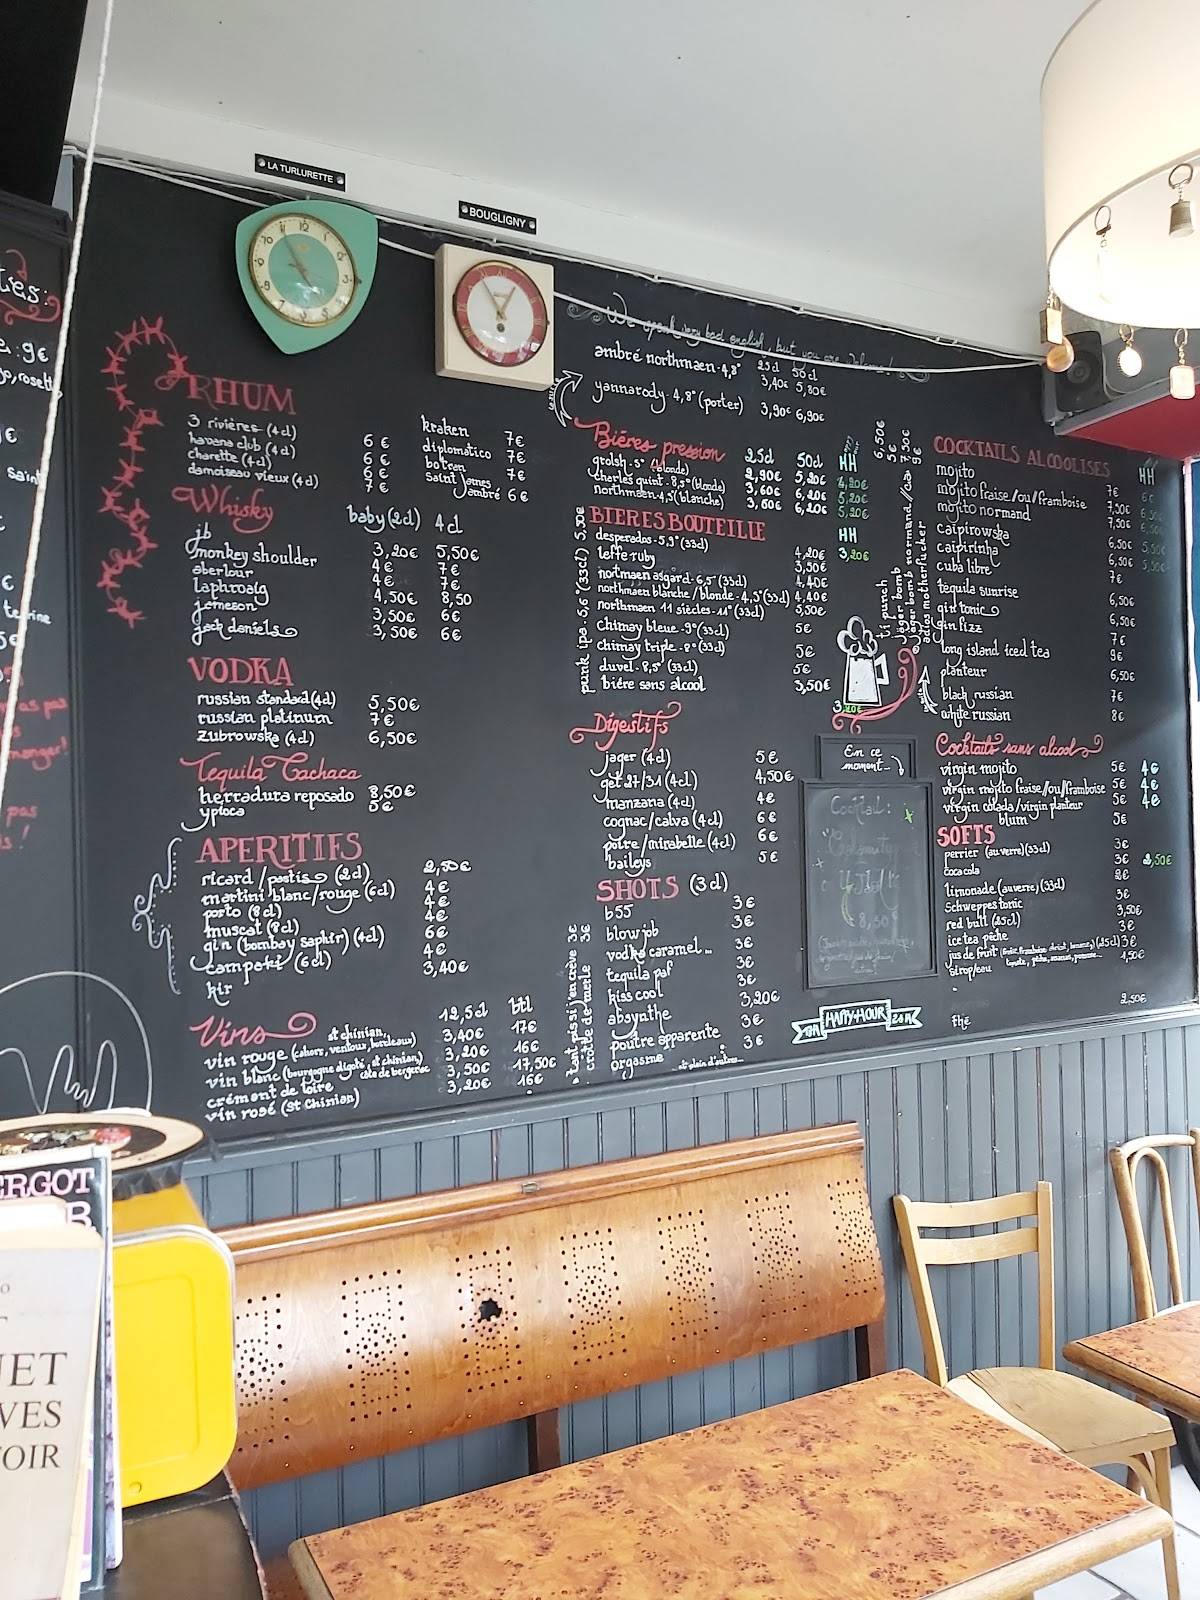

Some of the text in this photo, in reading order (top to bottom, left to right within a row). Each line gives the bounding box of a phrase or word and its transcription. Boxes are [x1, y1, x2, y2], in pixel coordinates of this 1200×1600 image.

[267, 161, 334, 183] LA TURLURETTE
[299, 222, 310, 232] 12
[469, 207, 526, 228] BOUGLIGNY
[594, 341, 643, 363] ambré
[761, 374, 789, 390] 3,40€
[186, 374, 297, 415] RHUM
[699, 391, 744, 415] (porter)
[187, 413, 264, 433] 3 rivières
[760, 402, 825, 423] 3,90€ 6,90€
[420, 414, 470, 437] kraken
[188, 431, 261, 451] havana club
[422, 438, 492, 462] diplomatico
[188, 447, 239, 463] charette
[933, 435, 1111, 479] COCKTAILS ALCOOLISES
[188, 462, 290, 483] damoiseau vieux
[594, 473, 726, 494] charles quint (blonde)
[744, 467, 827, 486] 2,90€ 5,20€
[936, 462, 975, 487] mojito
[745, 482, 827, 503] 3,60€ 6,20€
[937, 482, 978, 506] mojito
[172, 484, 274, 533] Whisky
[588, 505, 666, 531] BIERES
[794, 502, 828, 516] 6,20€
[937, 500, 1131, 524] mojito normand 7,50€
[904, 500, 914, 566] normand
[1107, 516, 1132, 530] 7,50€
[595, 527, 870, 563] desperados 4,20€ 3,20€
[838, 527, 858, 544] HH
[937, 521, 1133, 551] caipirowska 6,50€
[190, 542, 318, 568] monkey shoulder
[372, 541, 480, 561] 3,20€ 5,50€
[631, 548, 827, 575] ruby 3,50€
[936, 540, 1135, 569] caipirinha 6,50€
[192, 561, 254, 579] aberlour
[915, 520, 932, 611] motherfucker
[936, 559, 992, 576] cuba libre
[193, 577, 270, 606] laphroaig
[794, 575, 829, 589] 4,40€
[937, 578, 1136, 608] tequila sunrise 6,50€
[373, 588, 473, 609] 4,50€ 8,50
[875, 578, 897, 621] punch
[372, 608, 416, 625] 3,50€
[645, 617, 680, 634] bleue
[959, 616, 984, 634] fizz
[1109, 615, 1137, 628] 6,50€
[228, 617, 418, 641] daniels 3,50€
[644, 639, 678, 663] triple
[941, 638, 1051, 668] long island iced tea
[187, 657, 294, 687] VODKA
[598, 659, 634, 673] duvel
[940, 658, 1136, 688] planteur 6,50€
[638, 676, 832, 695] sans alcool 3,50€
[197, 691, 421, 713] russian 5,50€
[942, 687, 976, 709] black
[974, 687, 1014, 701] russian
[197, 707, 334, 730] russian platinum
[972, 708, 1012, 722] russian
[368, 731, 418, 748] 6,50€
[936, 731, 1035, 757] Cocktails sans
[754, 768, 795, 786] 4,50€
[940, 759, 1018, 788] virgin mojito
[198, 785, 355, 811] herradura reposado
[605, 797, 666, 811] manzana
[998, 812, 1029, 827] blum
[937, 824, 996, 848] SOFTS
[194, 832, 364, 870] APERITIFS
[944, 849, 979, 869] perrier
[606, 852, 652, 877] baileys
[201, 866, 255, 887] ricard
[200, 887, 266, 906] martini
[596, 875, 680, 902] SHOTS
[944, 881, 997, 899] limonade
[203, 903, 242, 933] porto
[604, 903, 634, 921] b55
[945, 904, 1143, 932] red bull 3,50€
[204, 918, 263, 939] muscat
[648, 935, 703, 958] caramel
[422, 959, 470, 978] 3,40€
[606, 960, 674, 993] tequila paf
[206, 981, 233, 1007] kir
[508, 995, 534, 1016] btl
[635, 980, 781, 1009] cool 3,20€
[189, 1011, 317, 1048] Vins
[442, 1019, 538, 1044] 3,40€ 17€
[607, 1003, 672, 1040] absynthe
[609, 1022, 722, 1060] poutre apparente
[203, 1039, 540, 1075] vin rouge 3,20€ 16€
[610, 1052, 665, 1080] orgasme
[205, 1056, 558, 1090] vin blanc 3,50€ 17,50€
[280, 1072, 544, 1099] de 3,20€ 16€
[204, 1102, 277, 1123] vin rosé
[0, 1352, 68, 1387] ET
[0, 1444, 61, 1471] OIR
